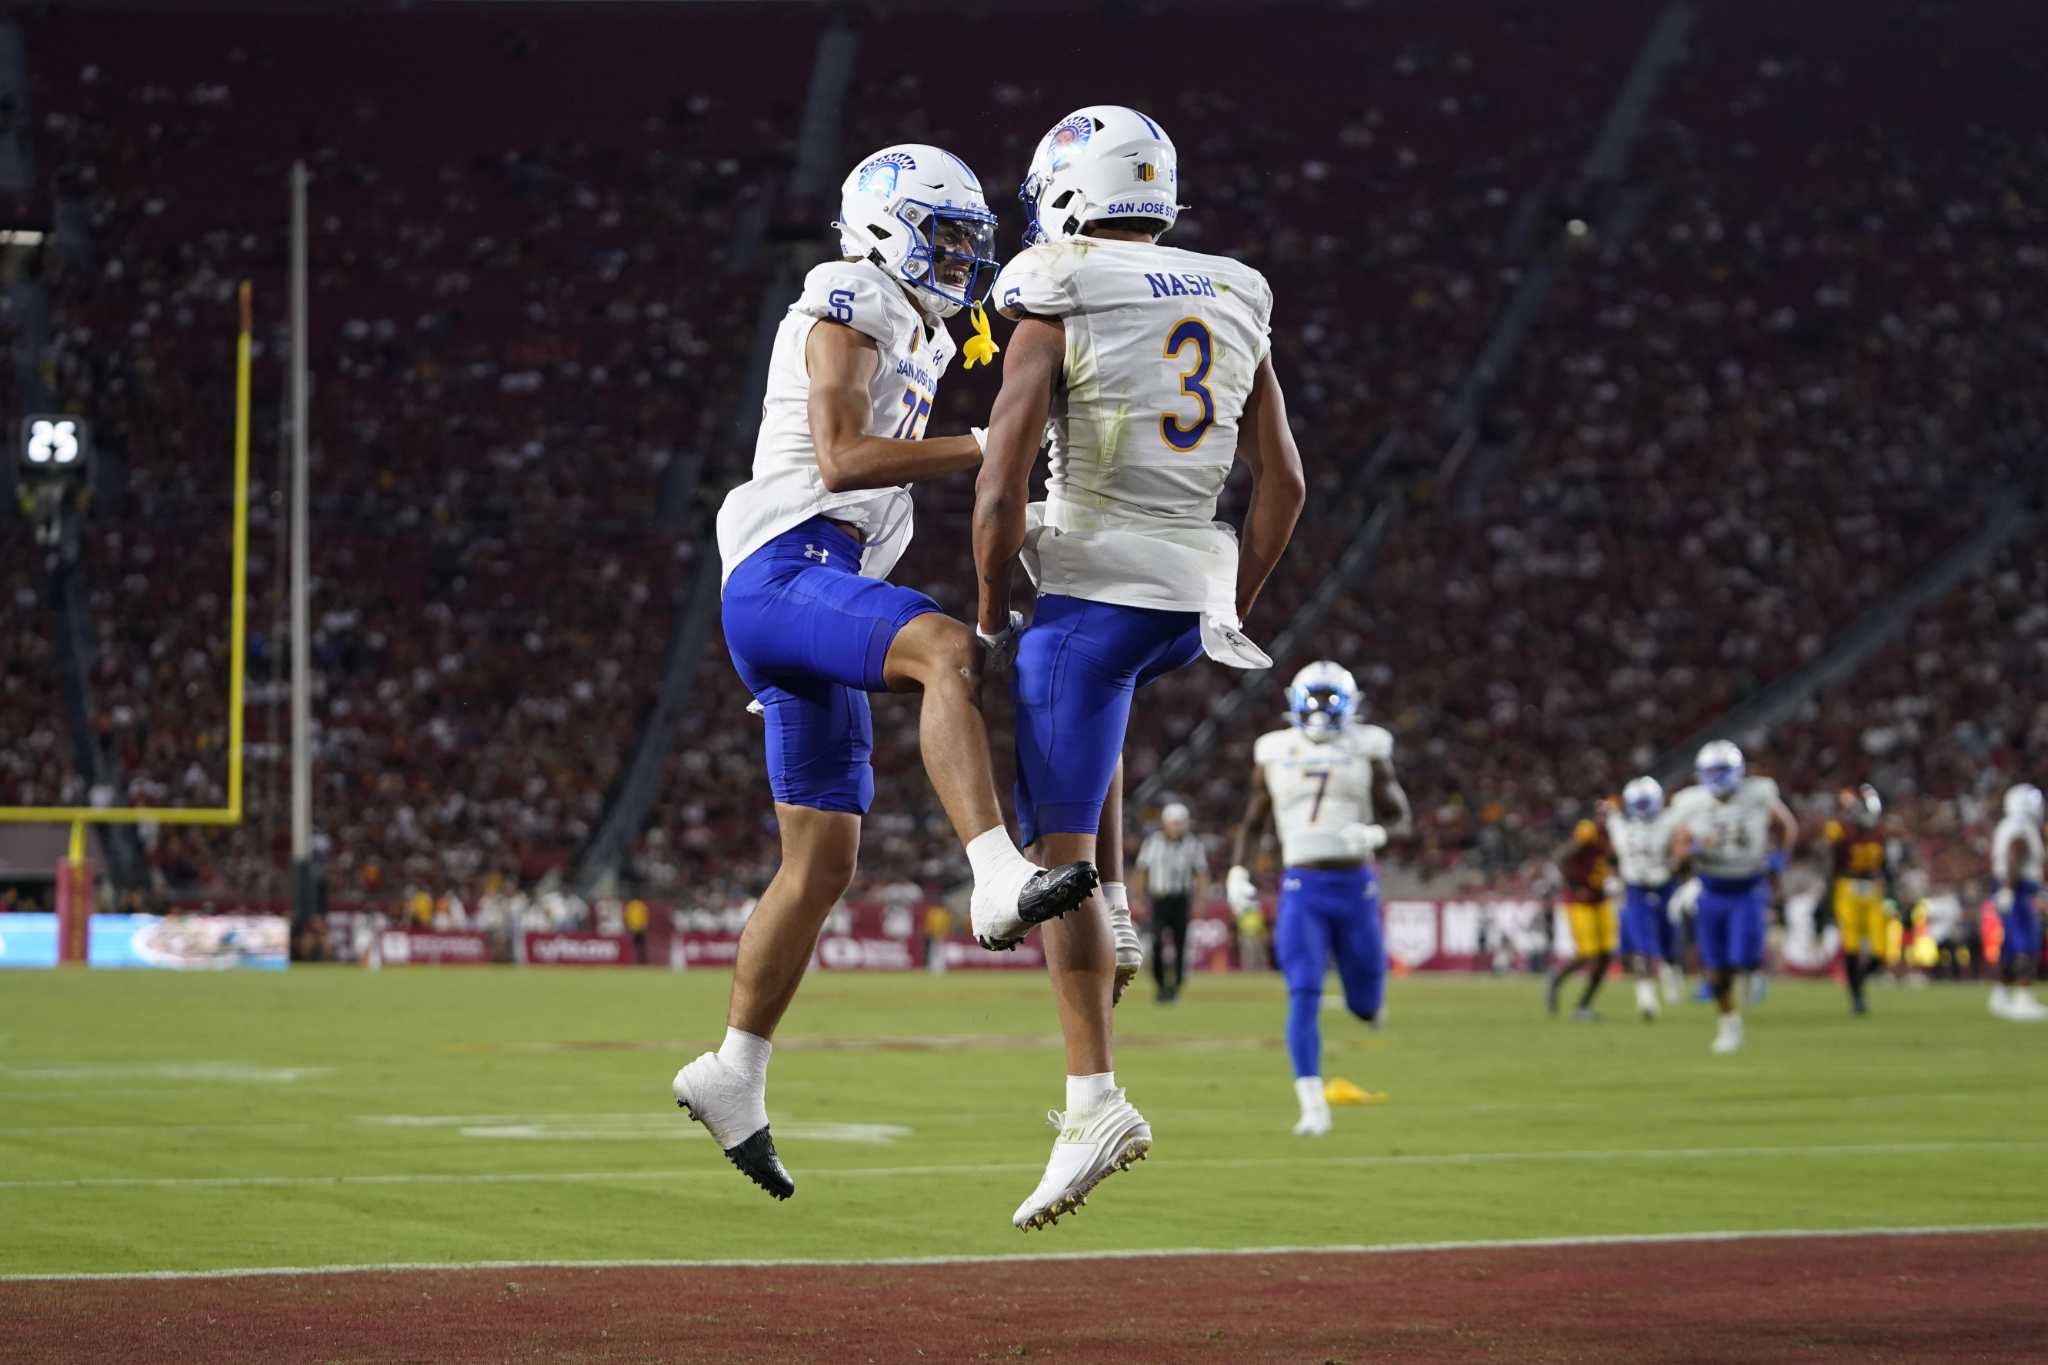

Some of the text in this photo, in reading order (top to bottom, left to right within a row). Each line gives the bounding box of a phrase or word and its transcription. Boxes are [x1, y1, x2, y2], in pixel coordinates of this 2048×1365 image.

[1108, 203, 1135, 215] SAN
[1137, 202, 1165, 215] JOSÉ
[1143, 272, 1217, 298] NASH
[896, 359, 914, 378] SAN
[1160, 316, 1217, 453] 3
[1303, 767, 1330, 824] 7
